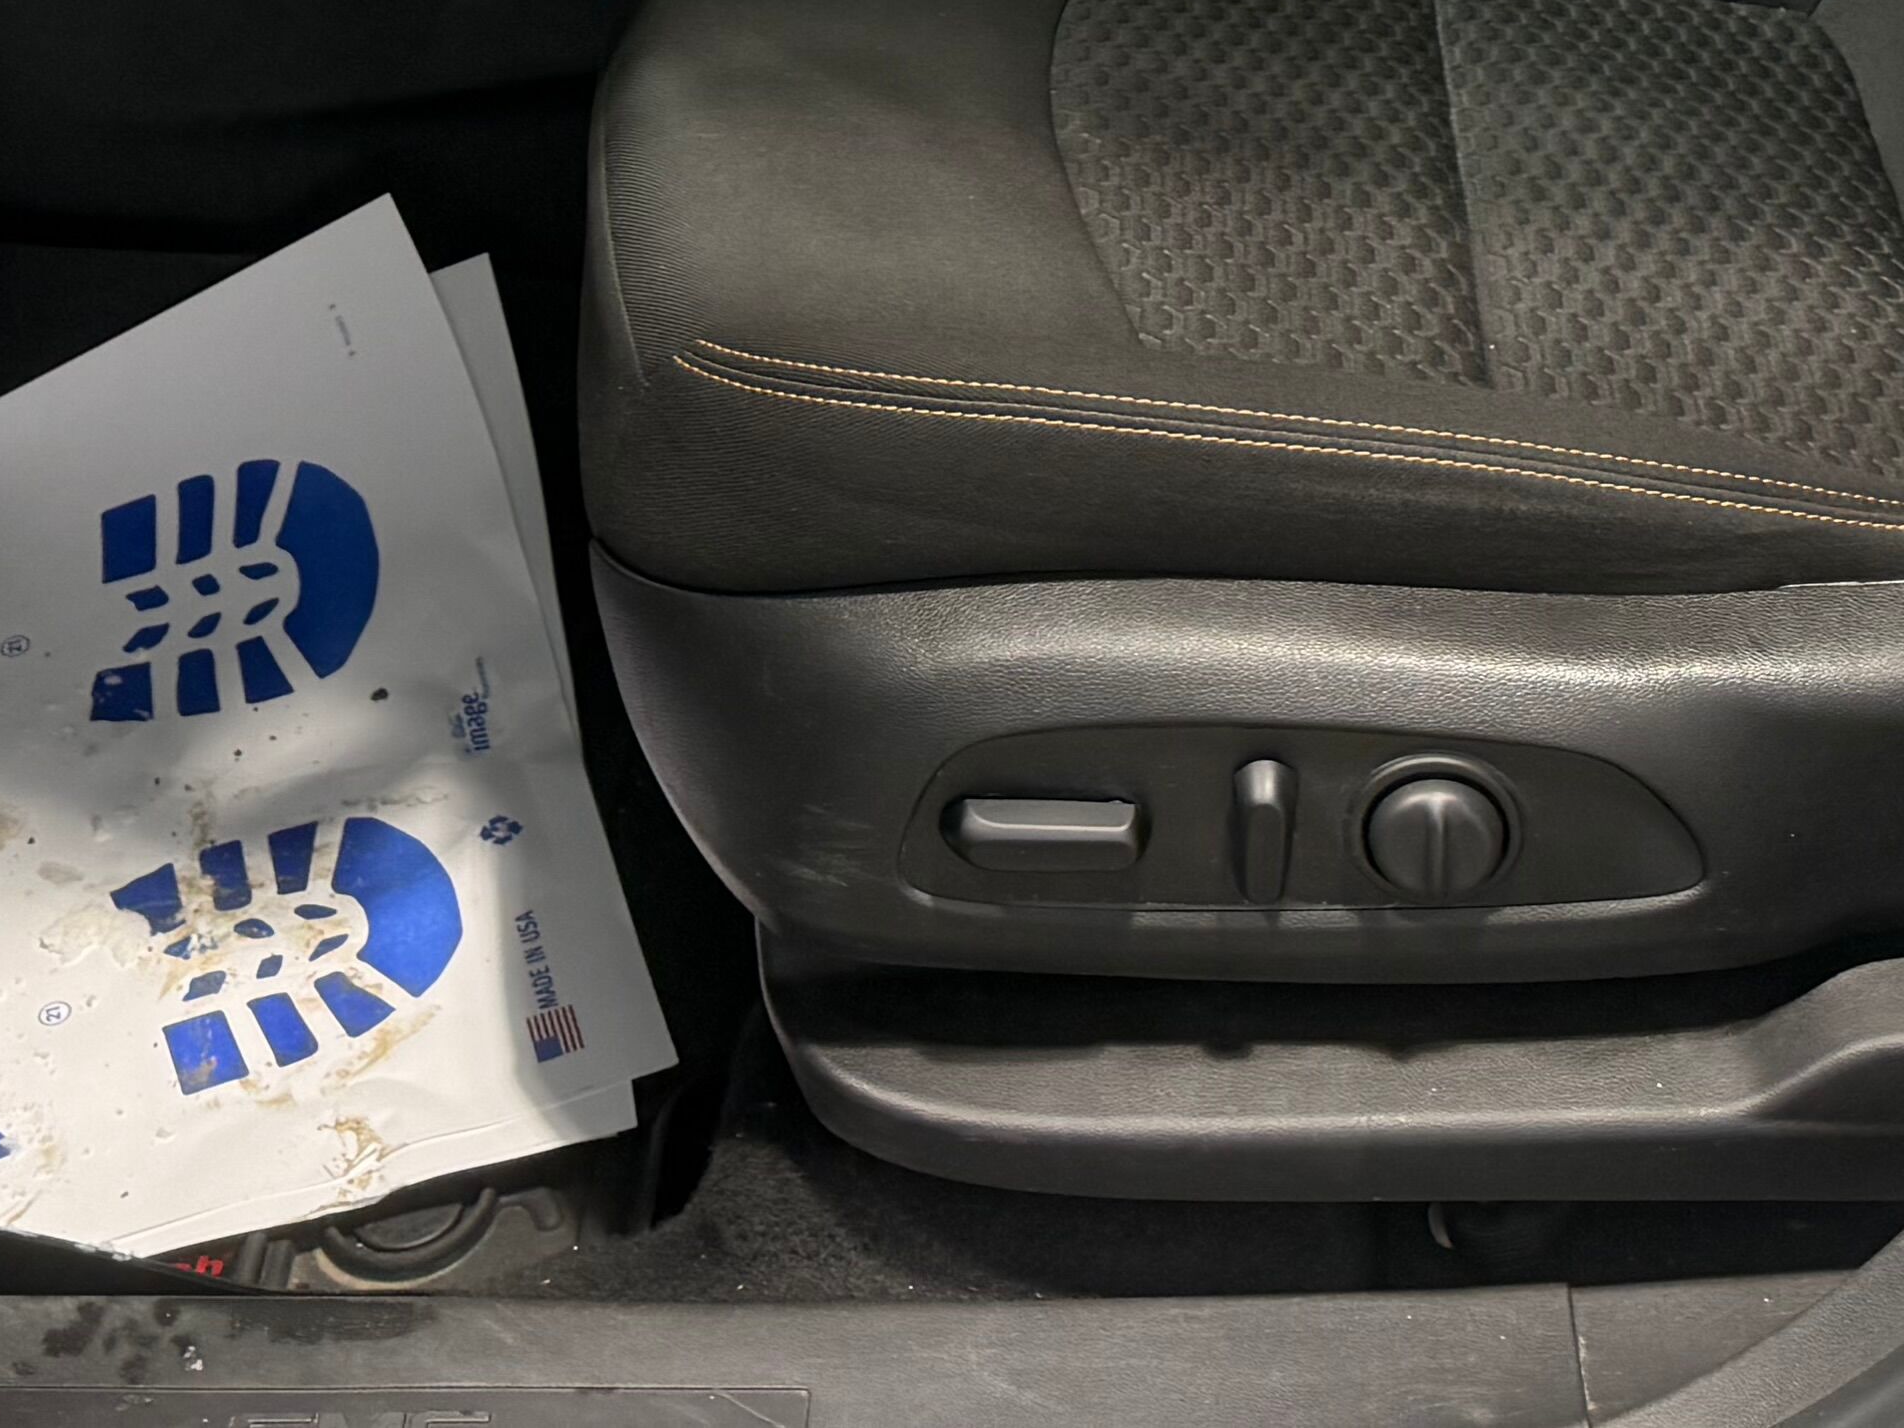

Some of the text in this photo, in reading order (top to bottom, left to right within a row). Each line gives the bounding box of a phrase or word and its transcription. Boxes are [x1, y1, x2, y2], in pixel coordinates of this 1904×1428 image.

[461, 691, 490, 751] image
[515, 909, 559, 1010] MADE IN USA
